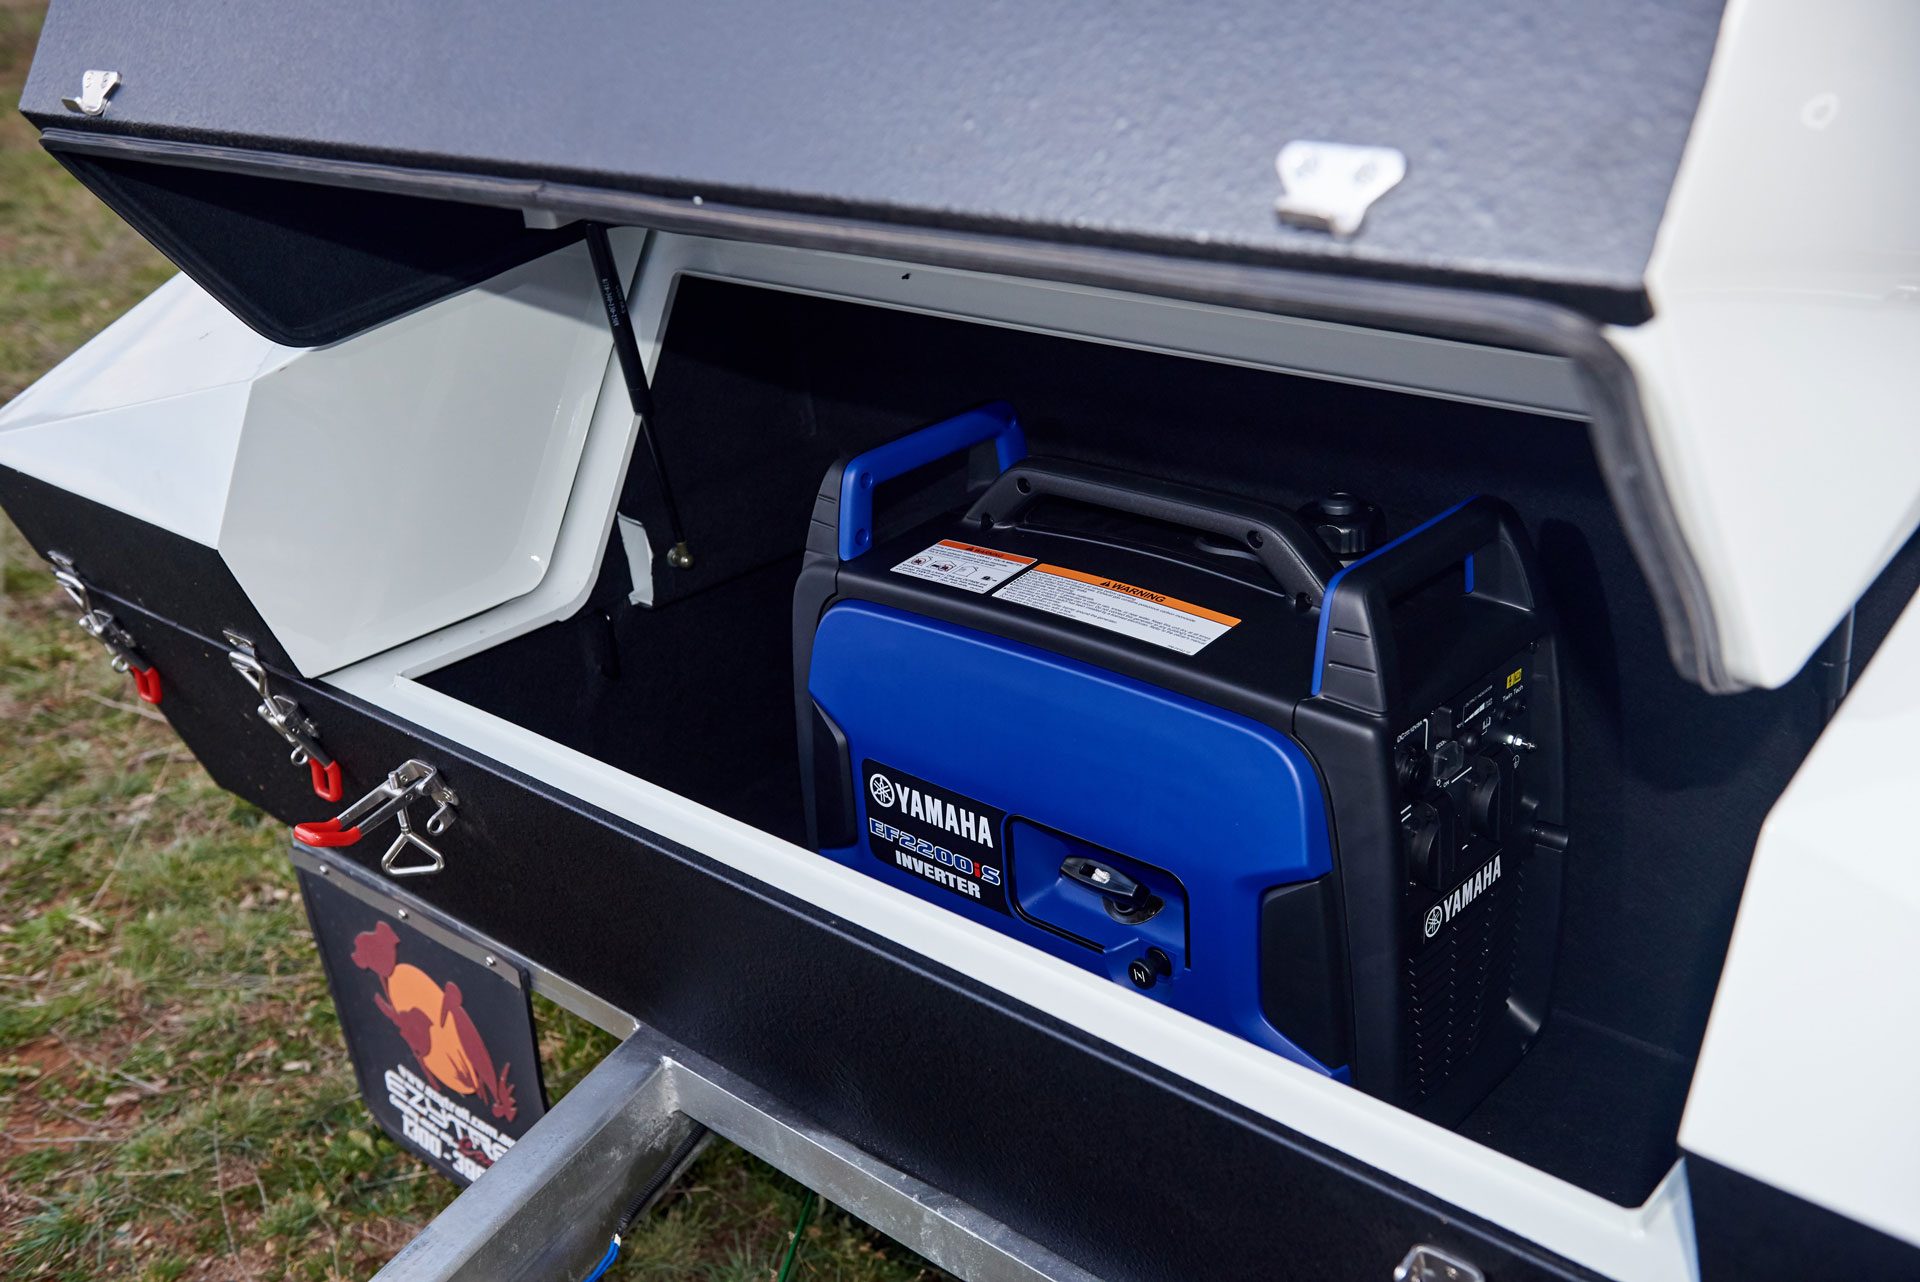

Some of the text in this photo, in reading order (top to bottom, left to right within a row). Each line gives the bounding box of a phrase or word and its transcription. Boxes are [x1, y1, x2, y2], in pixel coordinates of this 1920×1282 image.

[1112, 583, 1166, 602] WARNING
[895, 783, 993, 848] YAMAHA
[869, 817, 1000, 885] EF2200iS
[895, 850, 981, 898] INVERTER
[1443, 855, 1501, 922] YAMAHA
